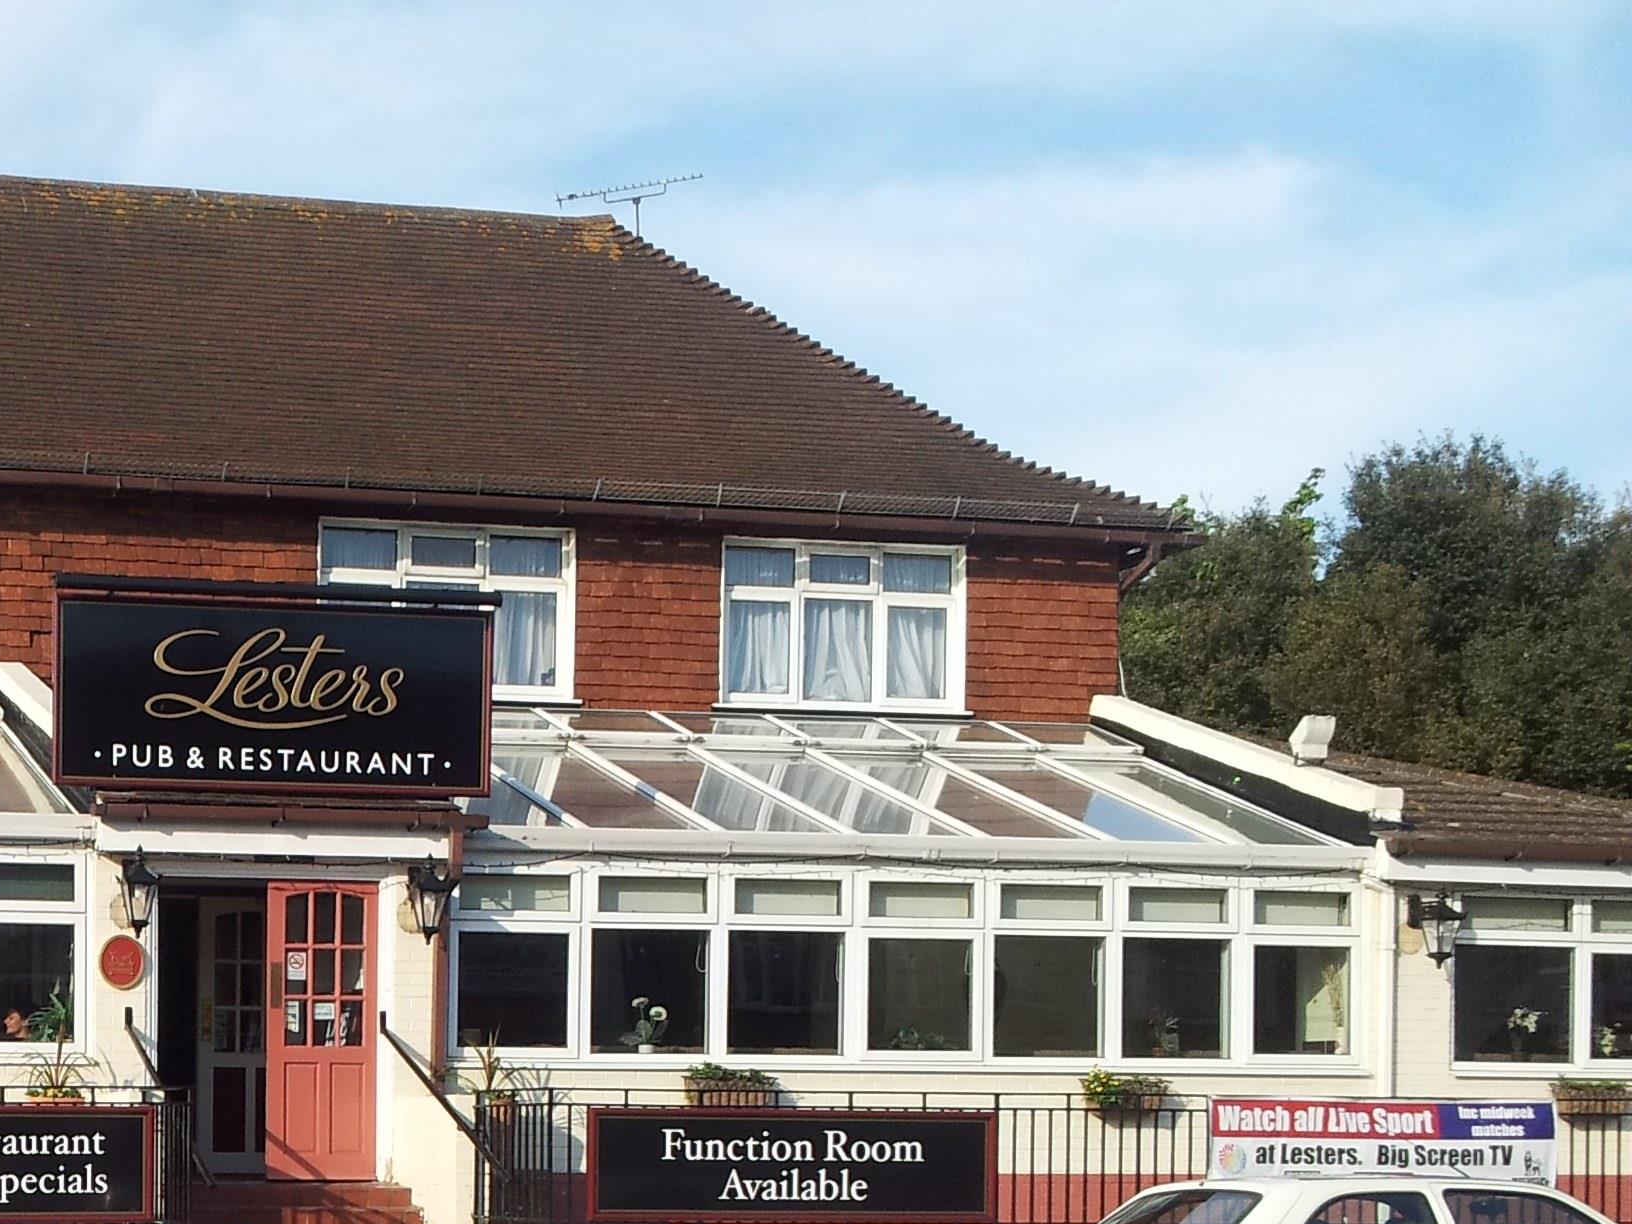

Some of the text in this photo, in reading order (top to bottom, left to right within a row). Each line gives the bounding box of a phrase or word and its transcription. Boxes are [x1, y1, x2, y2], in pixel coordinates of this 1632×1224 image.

[144, 627, 406, 730] Lesters
[112, 744, 435, 776] PUB & RESTAURANT
[1217, 1105, 1433, 1136] Watch all Live Sport
[1480, 1106, 1535, 1119] midweek
[1471, 1123, 1525, 1137] matches
[661, 1129, 924, 1163] Function Room
[1256, 1143, 1514, 1168] at Lesters. Big Screen TV
[717, 1169, 868, 1201] Available
